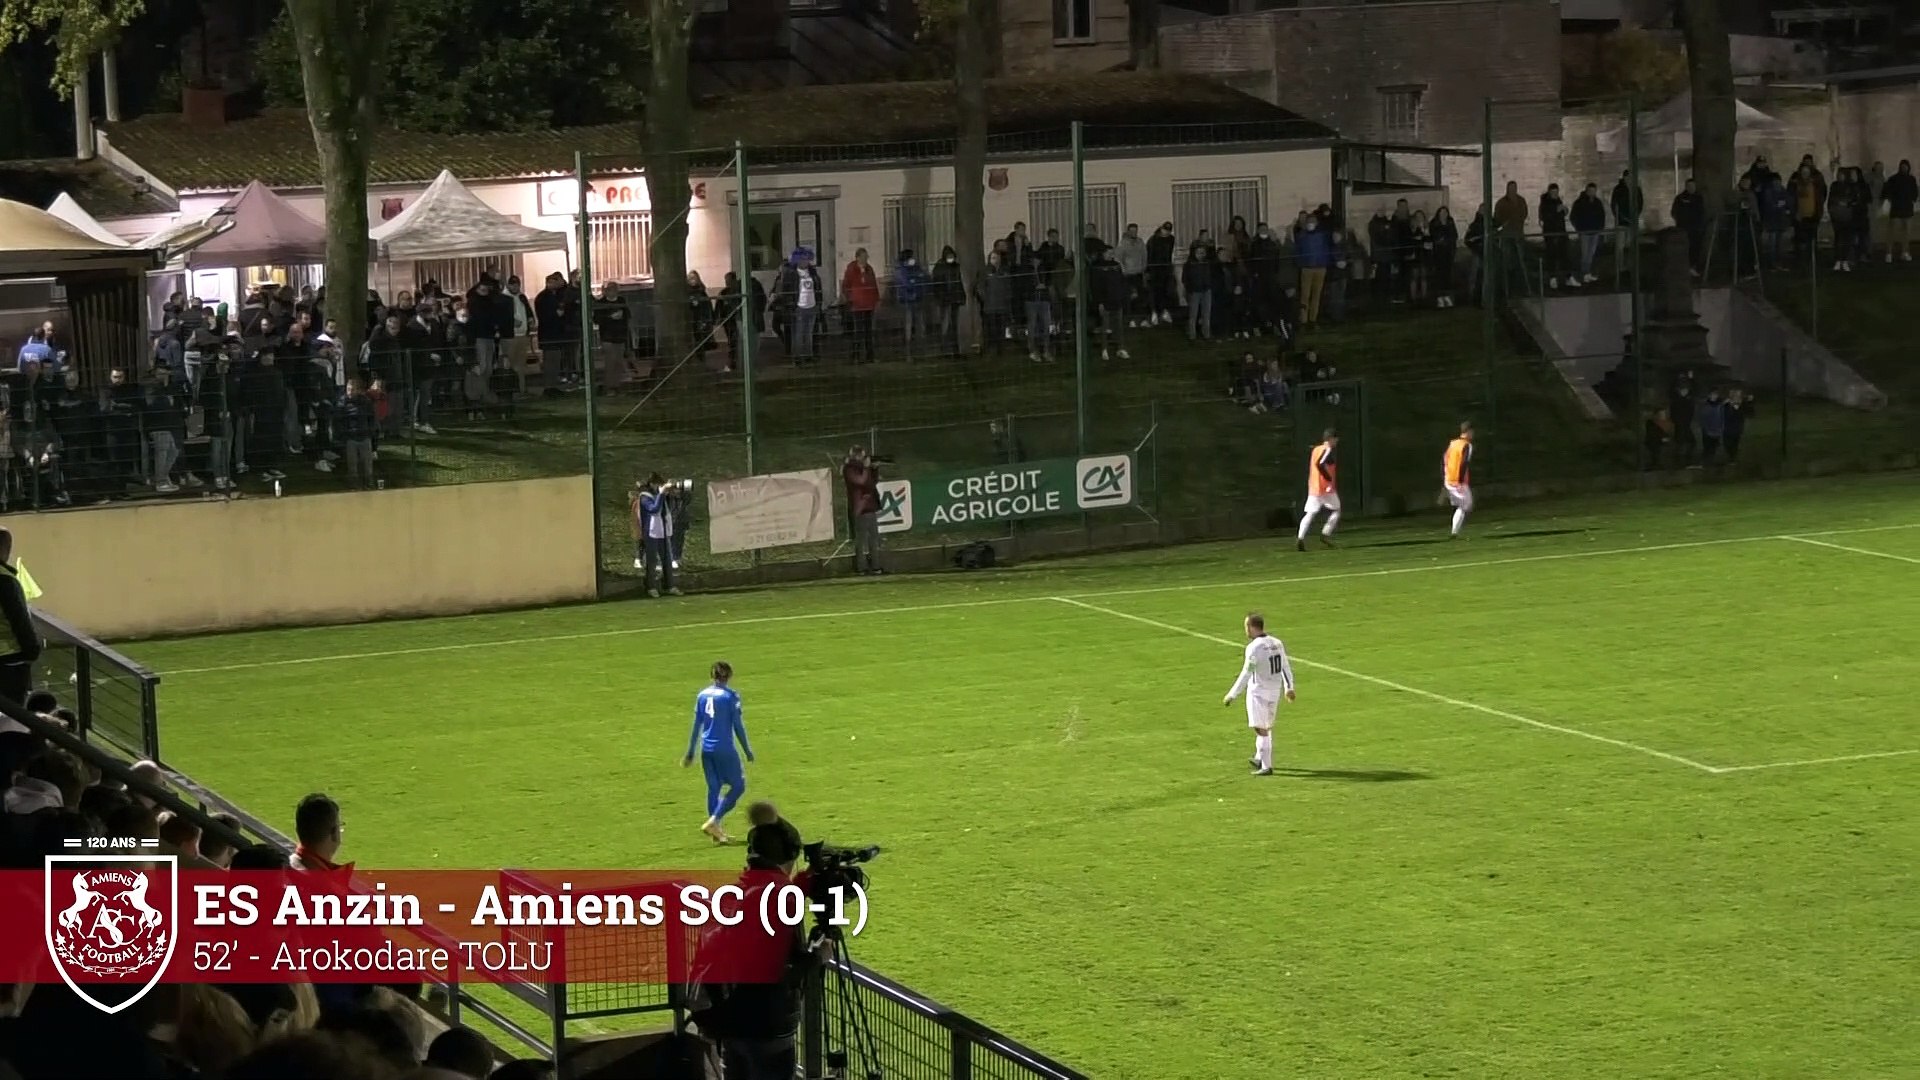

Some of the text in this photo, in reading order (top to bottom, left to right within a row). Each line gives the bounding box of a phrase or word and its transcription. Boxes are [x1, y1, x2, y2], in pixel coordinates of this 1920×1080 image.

[948, 470, 1042, 499] CRÉDIT
[931, 491, 1060, 525] AGRICOLE
[1269, 654, 1282, 675] 10
[705, 697, 714, 718] 4
